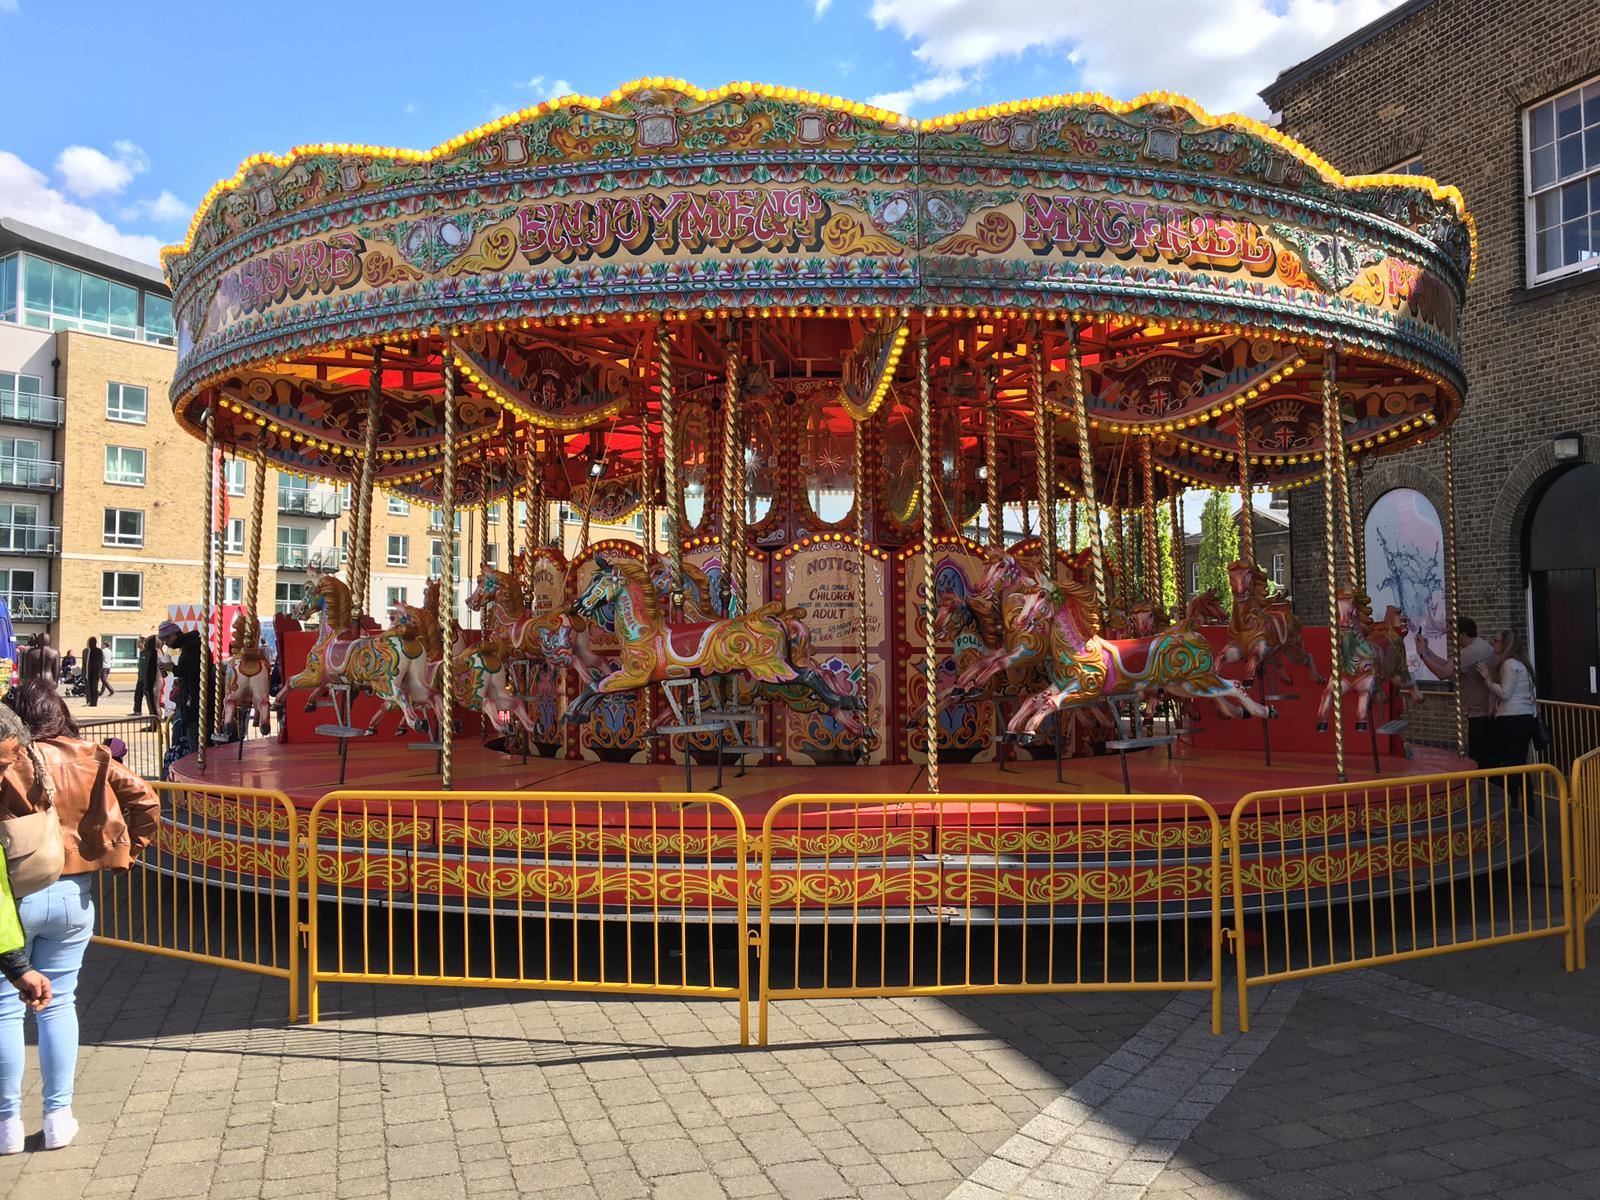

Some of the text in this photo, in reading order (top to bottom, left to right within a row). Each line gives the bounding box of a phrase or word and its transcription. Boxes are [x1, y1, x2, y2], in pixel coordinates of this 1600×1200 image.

[517, 187, 828, 262] ENJOYMENT
[1021, 193, 1275, 274] MICHAEL
[807, 557, 860, 576] NOTICE
[809, 588, 855, 600] CHILDREN
[812, 608, 846, 619] ADULT
